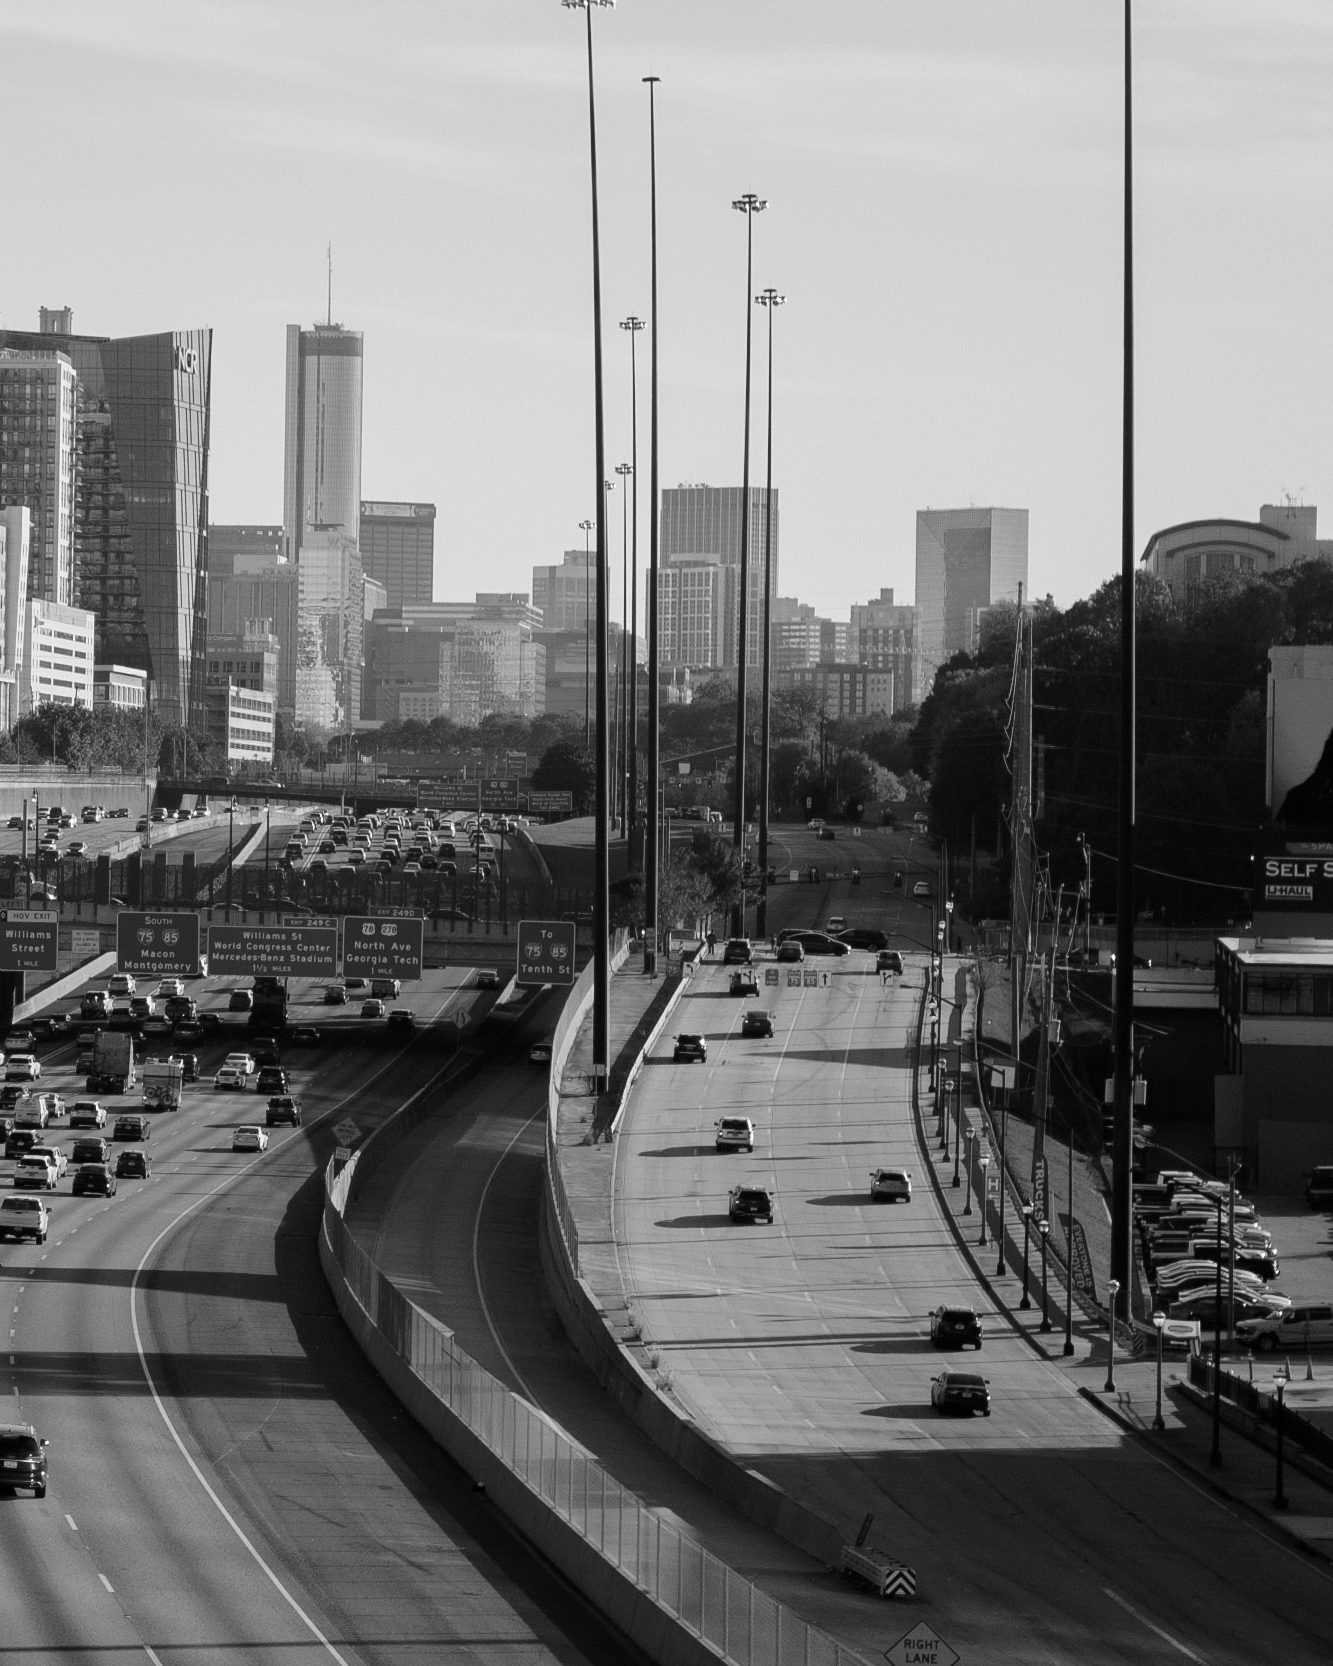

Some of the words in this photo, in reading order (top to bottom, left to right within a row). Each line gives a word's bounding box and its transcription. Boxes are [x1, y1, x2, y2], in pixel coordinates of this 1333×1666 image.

[178, 347, 198, 374] NCR
[1266, 860, 1318, 877] SELF
[5, 930, 51, 939] Williams
[363, 925, 374, 933] 78
[382, 925, 397, 934] 278
[541, 930, 553, 938] To
[139, 933, 153, 942] 75
[163, 933, 178, 942] 85
[243, 931, 286, 940] Williams
[291, 932, 302, 940] St
[11, 944, 45, 952] Street
[214, 941, 241, 950] World
[246, 942, 292, 952] Congress
[297, 943, 330, 952] Center
[354, 941, 385, 950] North
[391, 942, 411, 951] Ave
[526, 946, 541, 955] 75
[552, 947, 566, 956] 85
[141, 949, 175, 958] Macon
[212, 953, 284, 962] Mercedes-Benz
[290, 954, 332, 963] Stadium
[346, 954, 388, 966] Georgia
[394, 956, 419, 964] Tech
[124, 961, 191, 972] Montgomery
[521, 964, 553, 974] Tenth
[558, 965, 570, 974] St
[988, 1178, 999, 1191] H
[1034, 1159, 1045, 1221] TRUCKS
[1073, 1224, 1090, 1276] EVERYONE
[1086, 1277, 1093, 1287] IS
[904, 1639, 940, 1650] RIGHT
[906, 1653, 938, 1664] LANE
